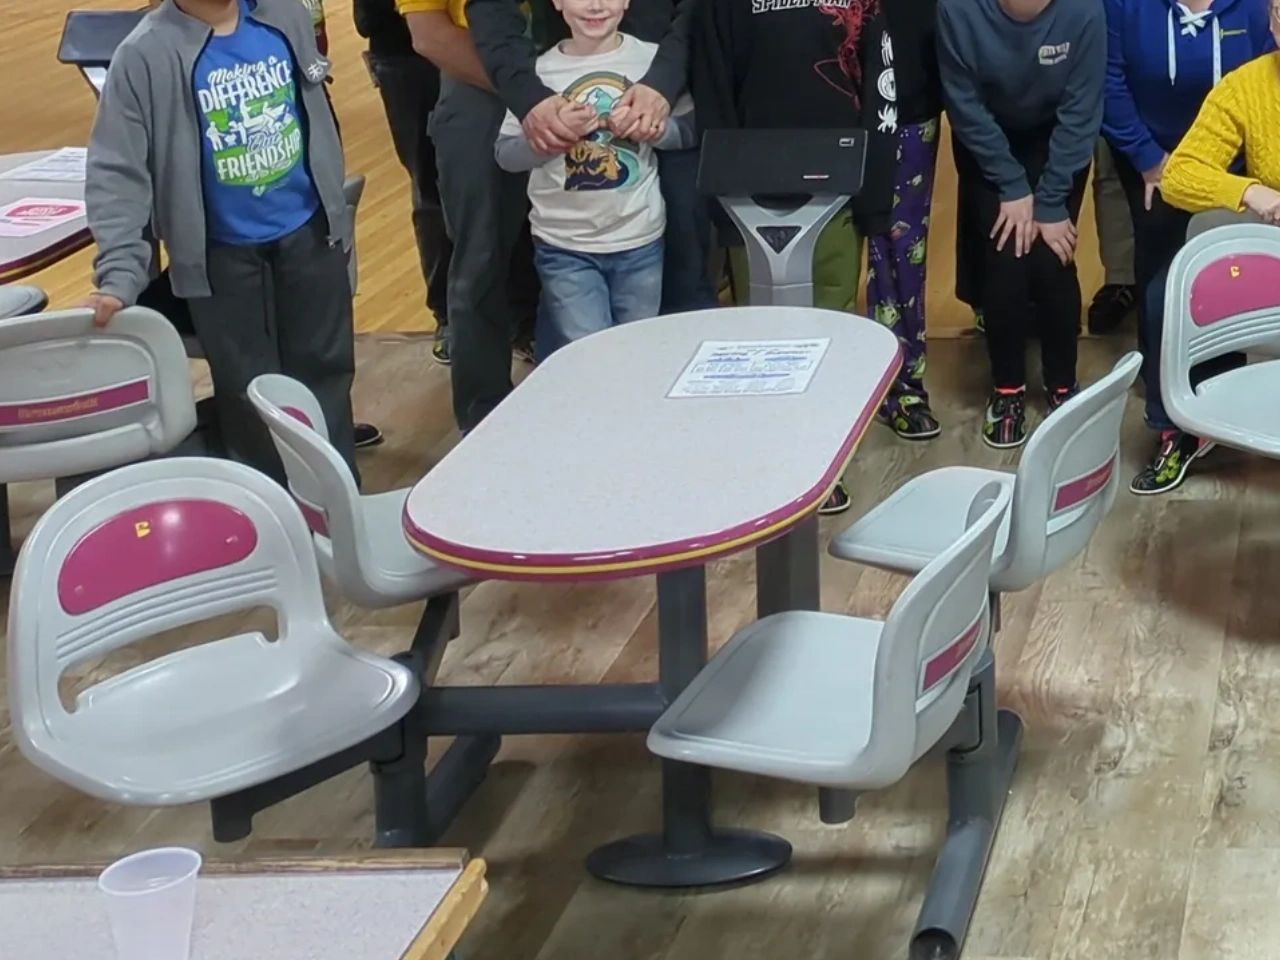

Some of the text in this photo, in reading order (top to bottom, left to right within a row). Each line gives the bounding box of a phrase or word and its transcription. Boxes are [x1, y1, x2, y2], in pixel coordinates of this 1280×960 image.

[198, 60, 293, 114] DIFFERENCE
[208, 56, 278, 84] Making a
